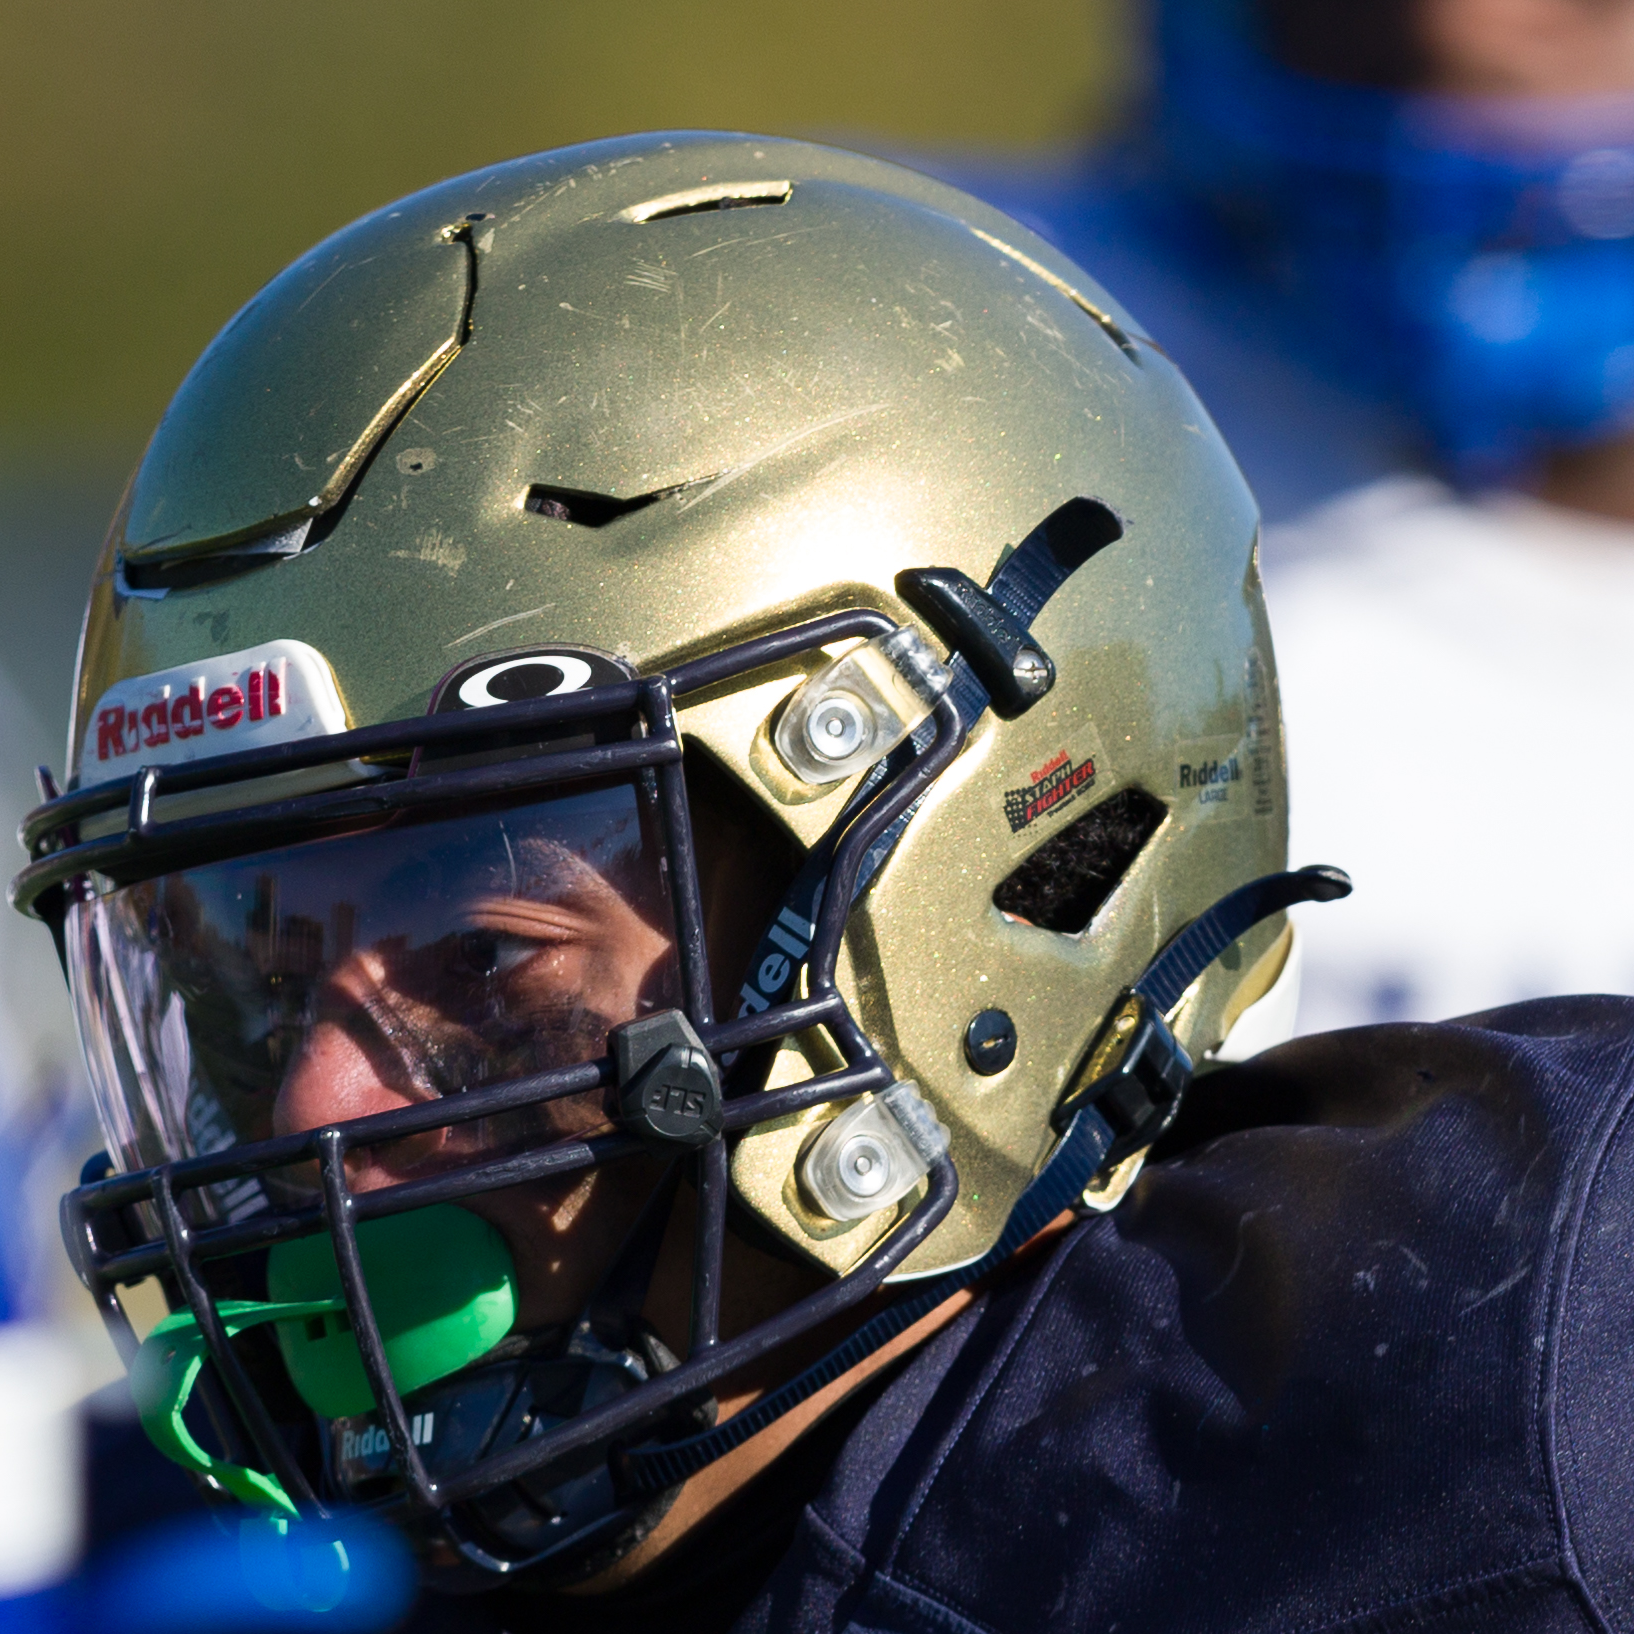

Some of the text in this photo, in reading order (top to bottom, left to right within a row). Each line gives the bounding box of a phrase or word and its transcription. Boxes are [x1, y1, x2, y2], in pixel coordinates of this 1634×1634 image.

[97, 656, 287, 761] Riddell
[1025, 761, 1072, 806] STAPH
[1026, 760, 1096, 822] FIGHTER
[1179, 758, 1241, 788] Riddell
[728, 906, 815, 1045] dell
[341, 1411, 434, 1461] Riddll
